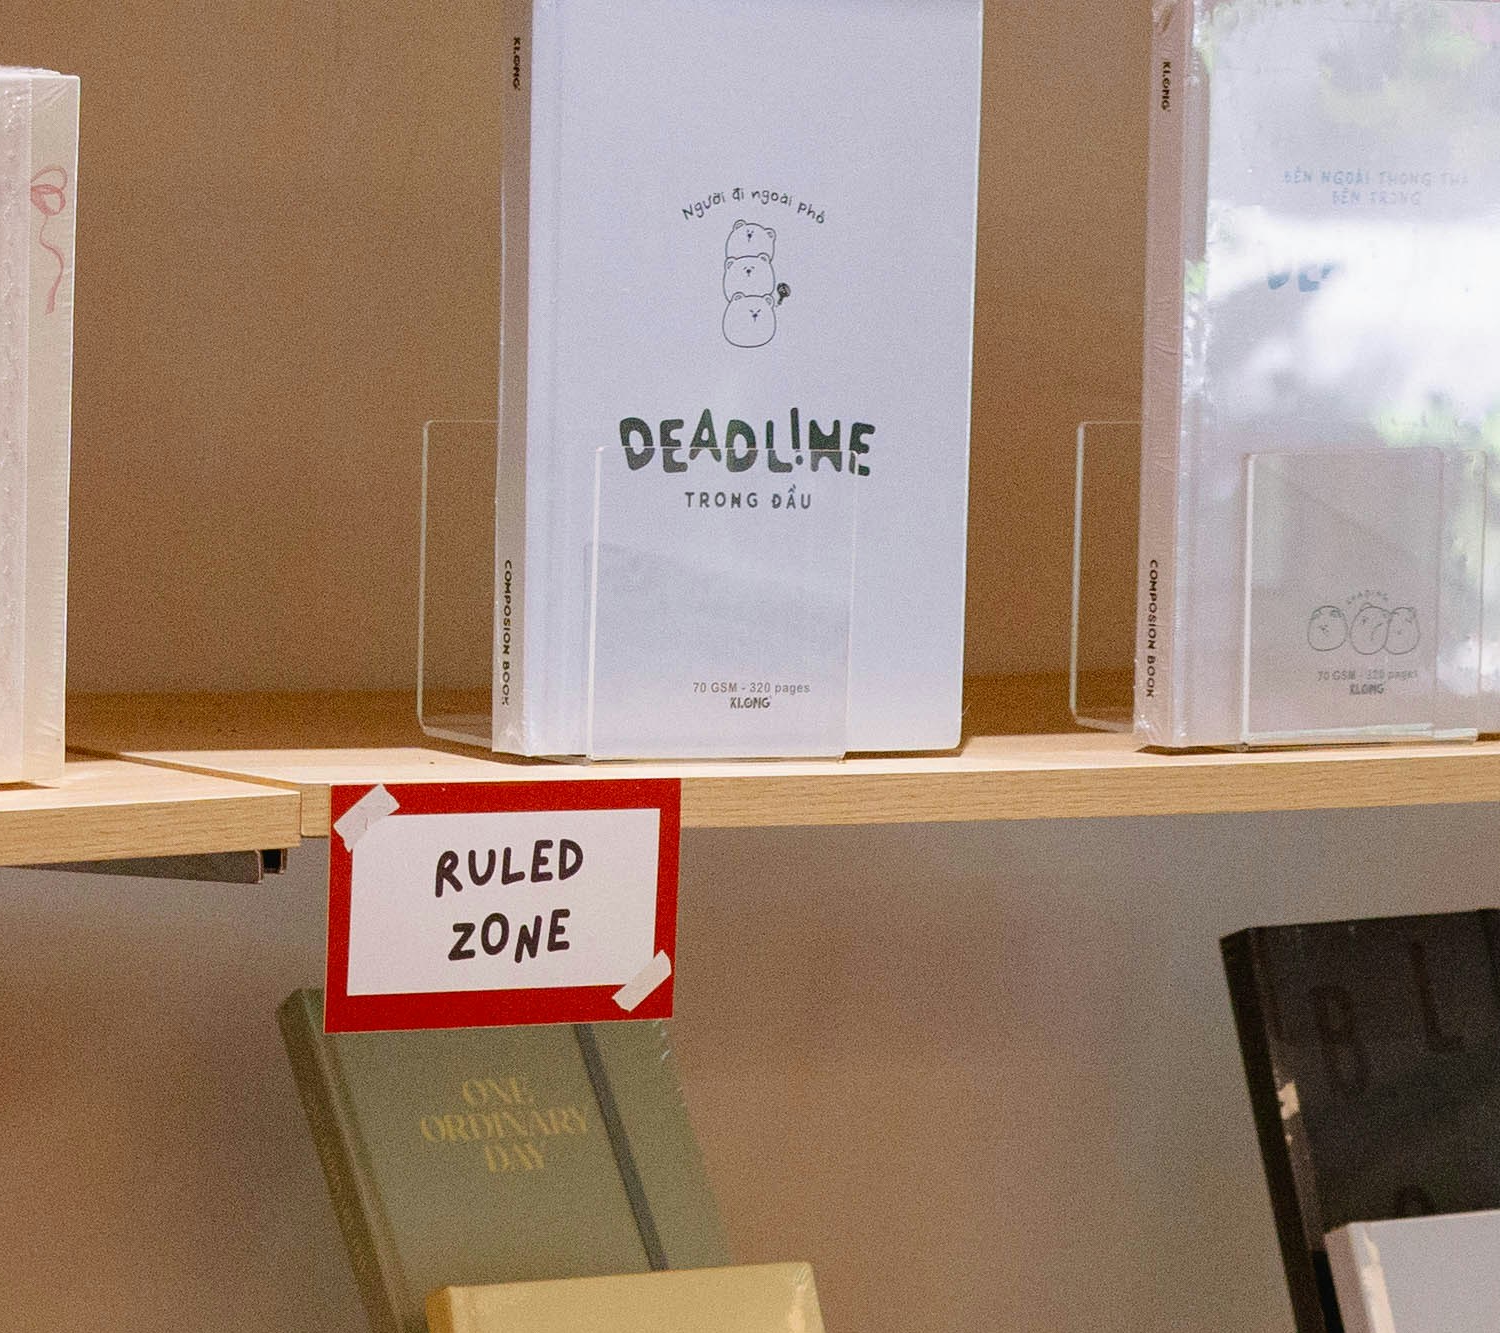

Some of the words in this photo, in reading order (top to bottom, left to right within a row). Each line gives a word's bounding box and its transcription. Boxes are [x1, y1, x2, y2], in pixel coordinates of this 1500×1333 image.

[684, 491, 759, 509] TRONG
[692, 682, 707, 694] 70
[710, 682, 738, 694] GSM
[749, 682, 771, 694] 320
[774, 684, 811, 696] pages
[434, 839, 584, 899] RULED
[447, 908, 571, 964] ZONE
